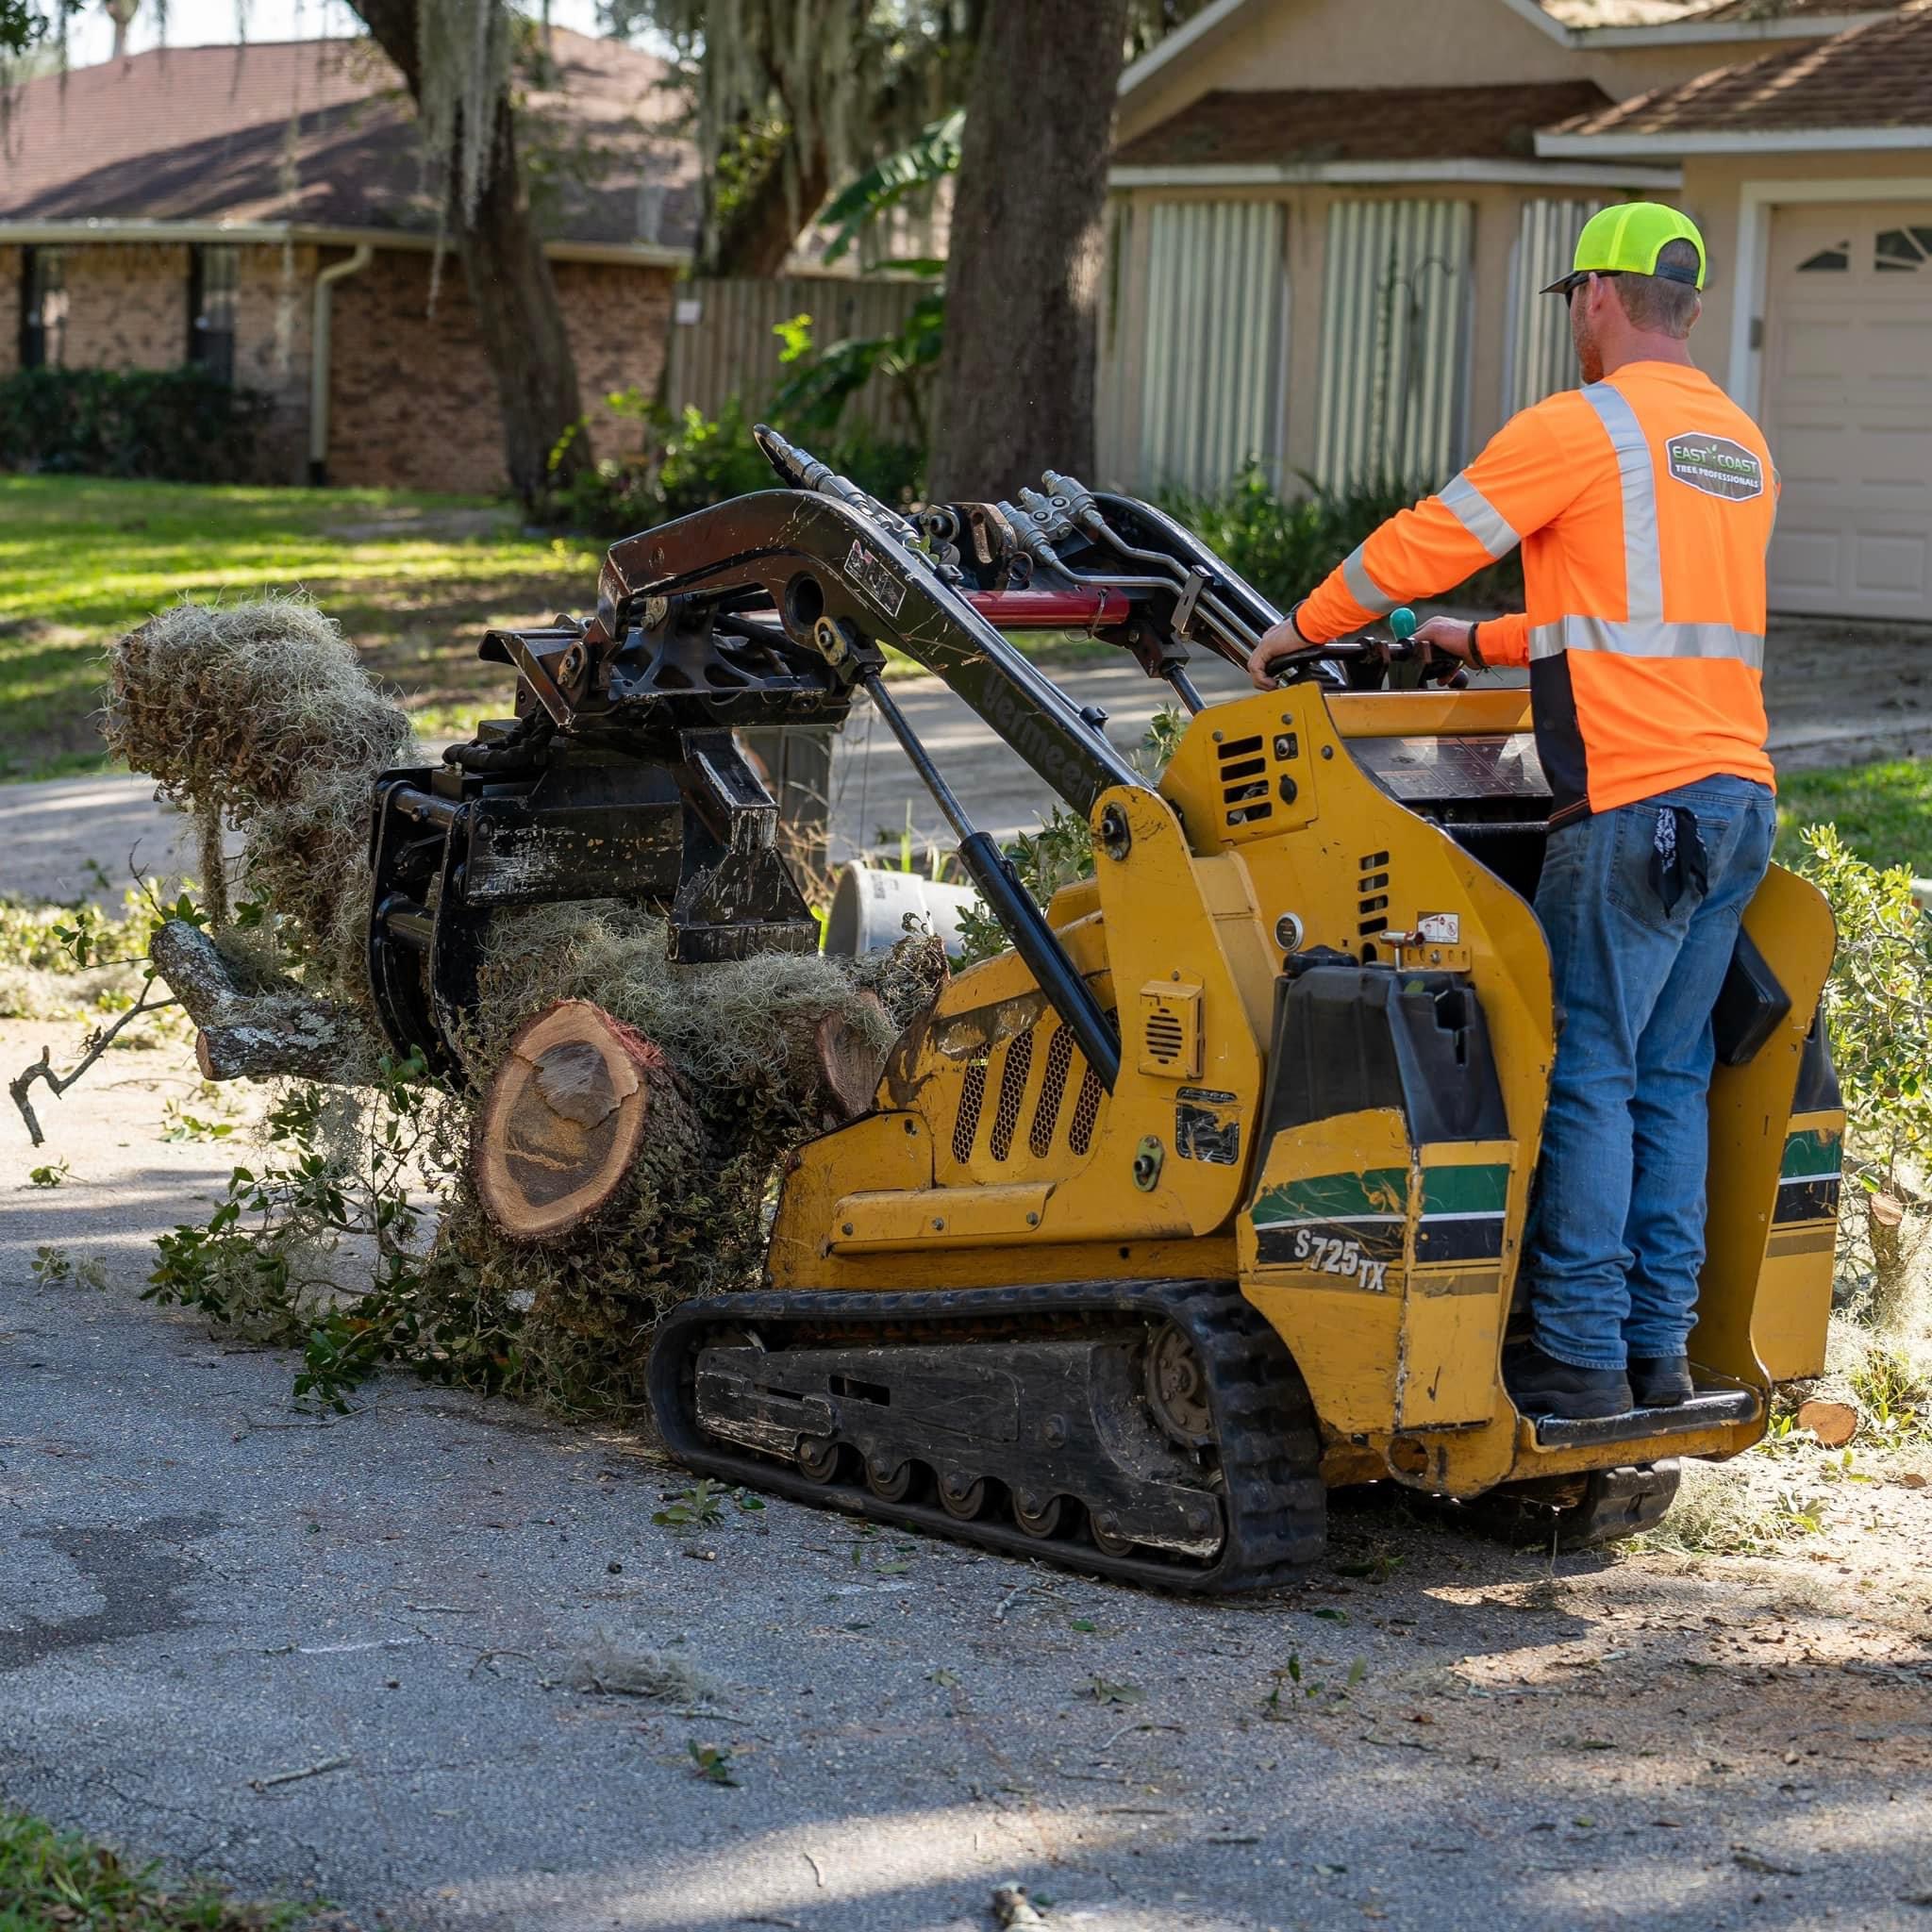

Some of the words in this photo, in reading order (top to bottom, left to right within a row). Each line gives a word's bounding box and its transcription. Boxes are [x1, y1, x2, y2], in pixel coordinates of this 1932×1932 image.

[1672, 445, 1707, 463] EAST
[1717, 454, 1757, 474] COAST
[1674, 464, 1698, 475] TREE
[1698, 468, 1758, 488] PROFESSIONALS
[982, 671, 1093, 801] Vermeer
